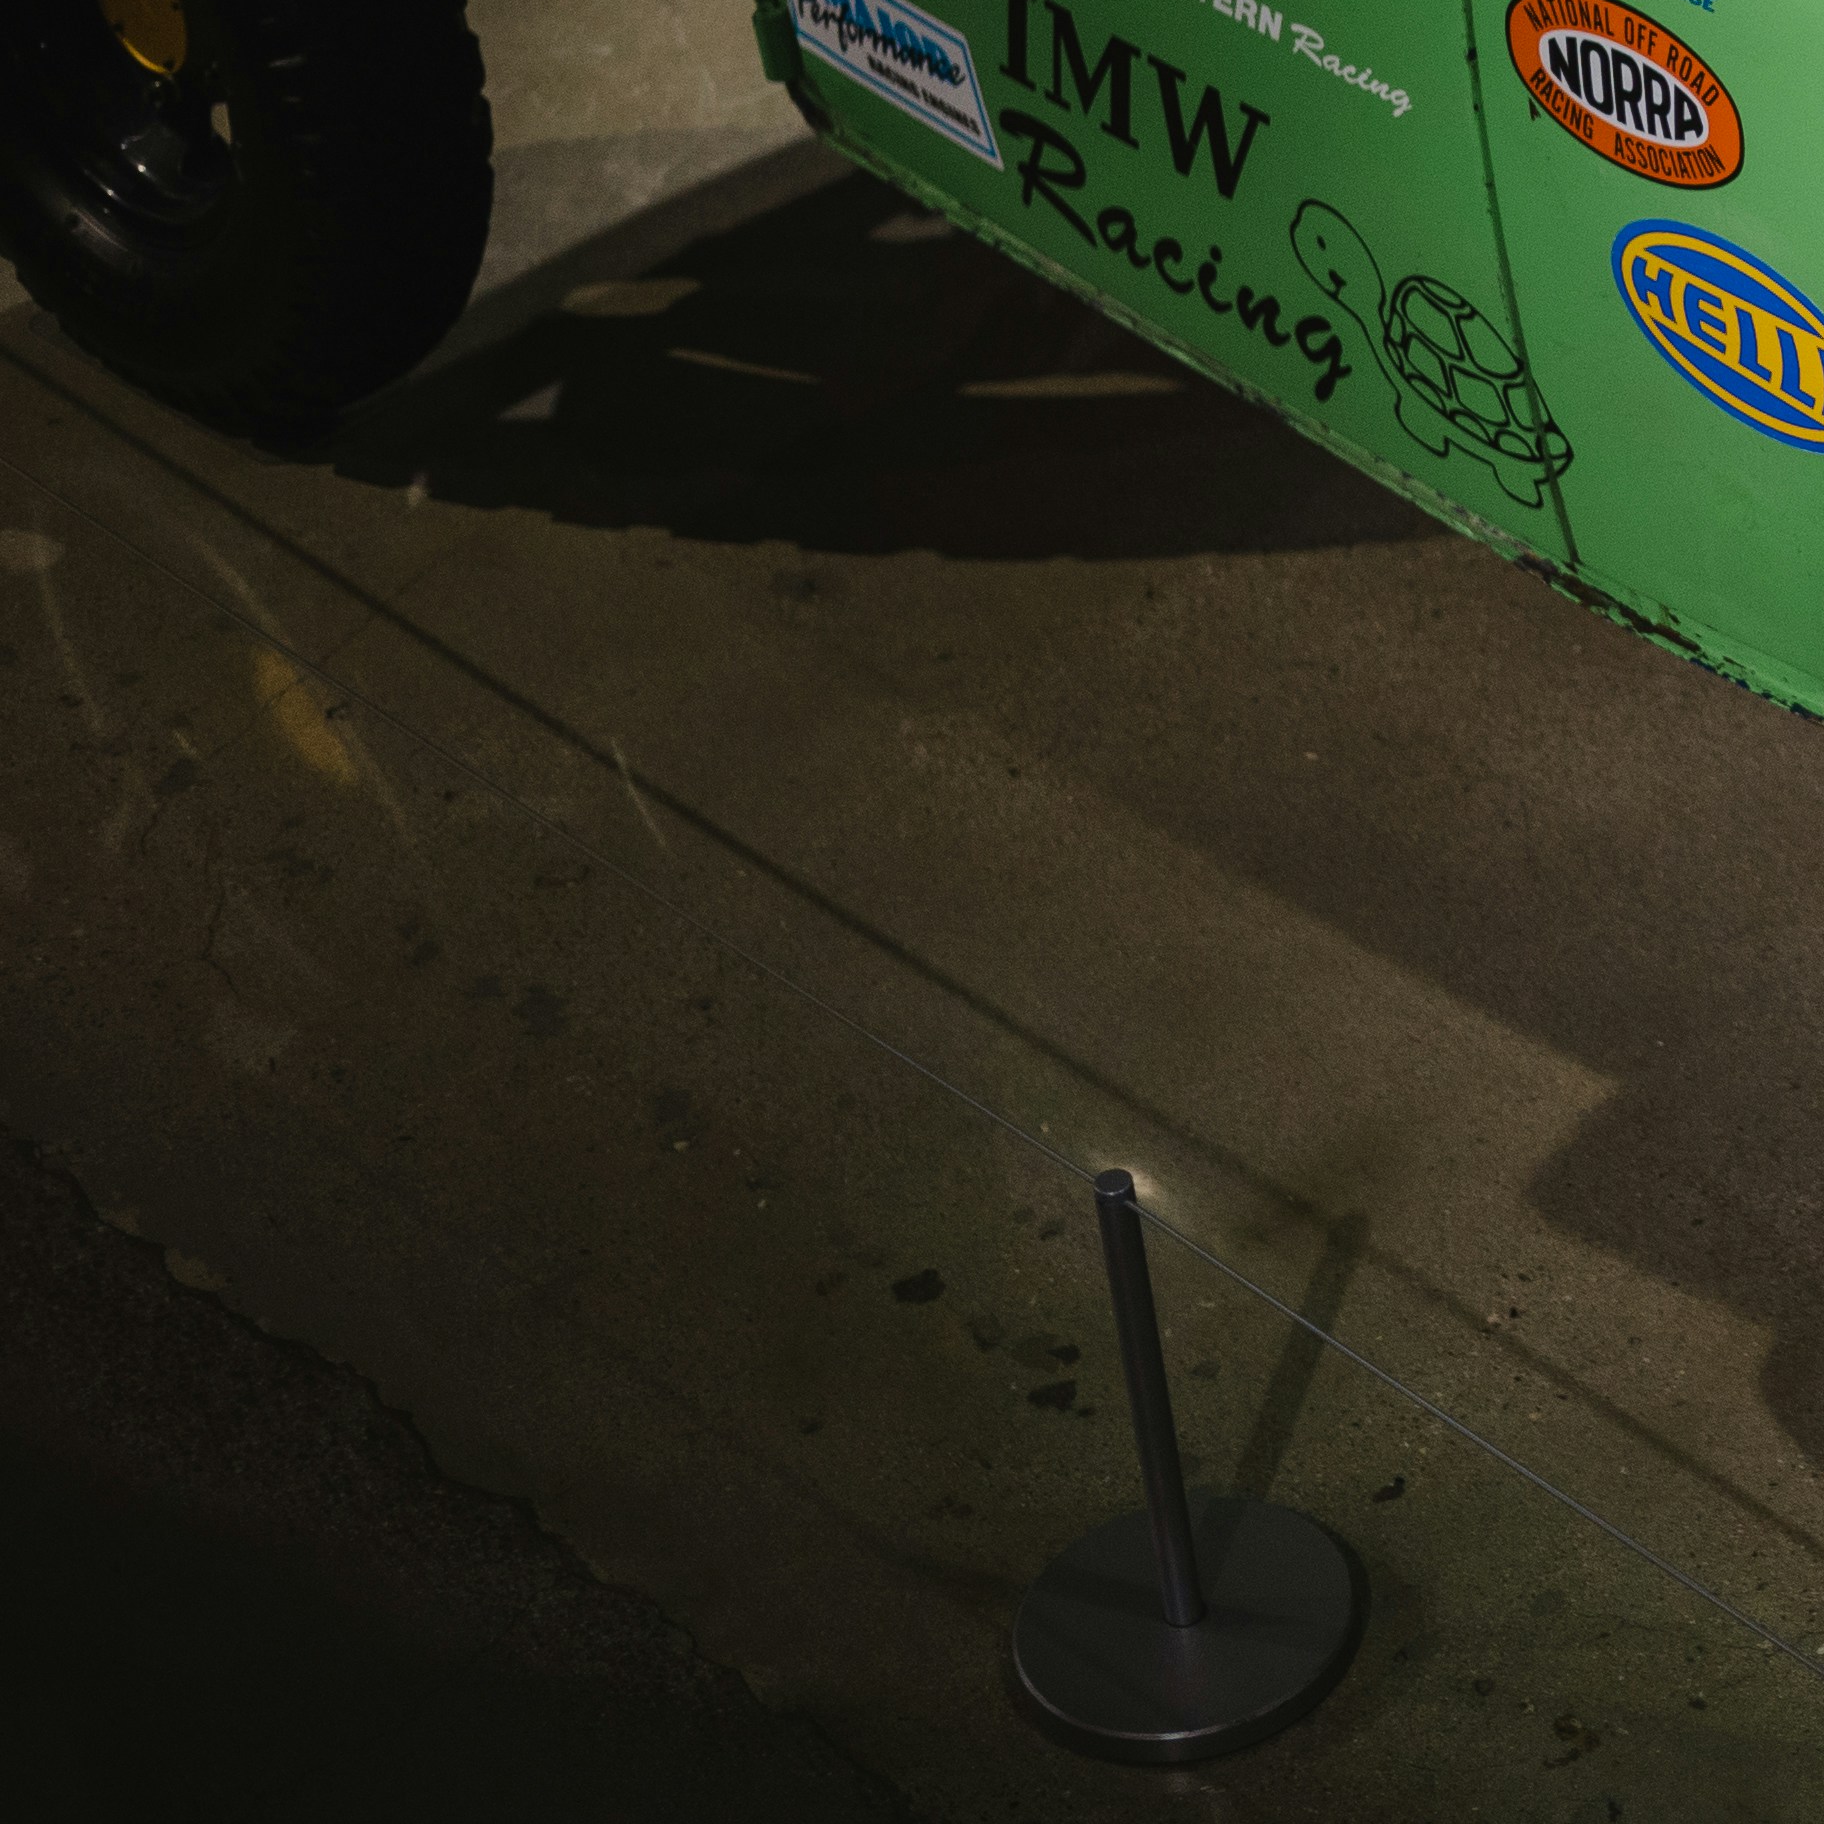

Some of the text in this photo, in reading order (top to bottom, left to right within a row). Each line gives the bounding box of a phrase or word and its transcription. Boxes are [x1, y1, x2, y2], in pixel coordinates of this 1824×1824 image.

[1290, 22, 1413, 118] Racing
[1548, 36, 1704, 141] NORRA
[1624, 16, 1658, 57] OFF
[1666, 43, 1720, 107] ROAD
[1530, 68, 1726, 180] RACING ASSOCIATION
[999, 108, 1353, 402] Racing
